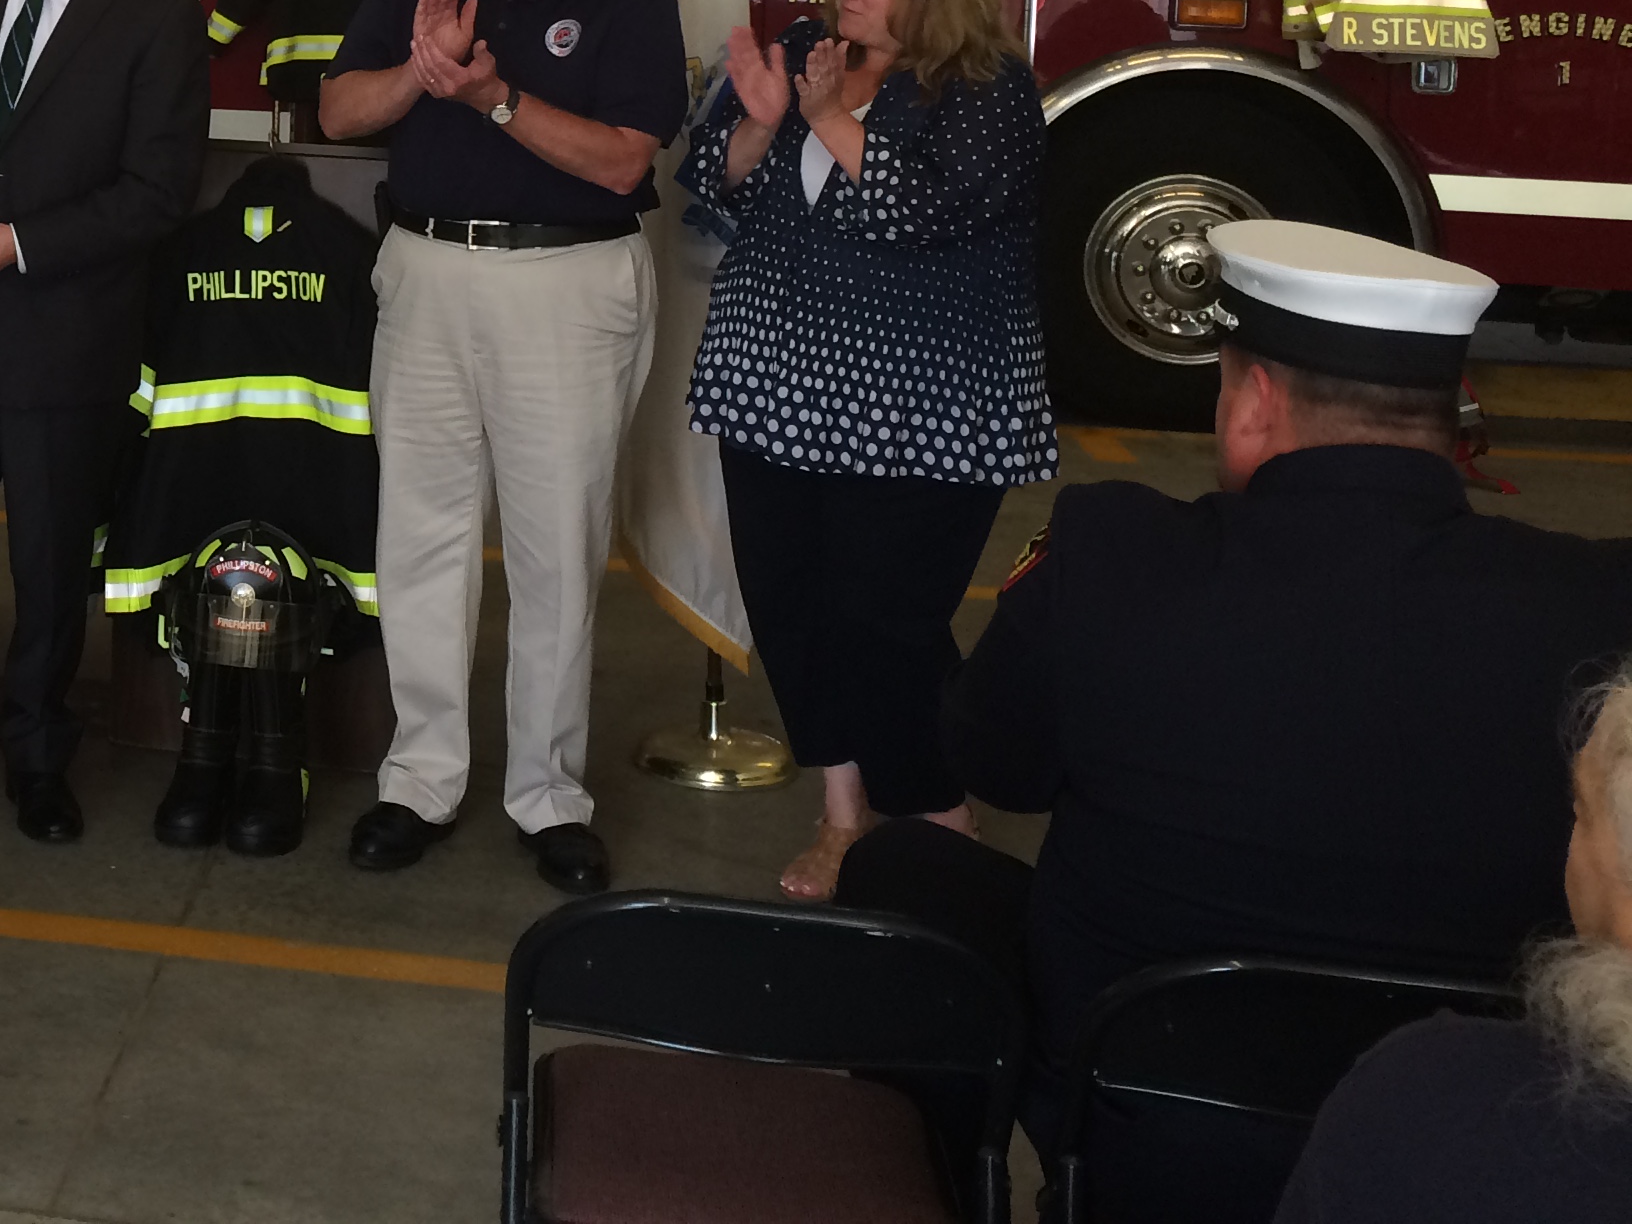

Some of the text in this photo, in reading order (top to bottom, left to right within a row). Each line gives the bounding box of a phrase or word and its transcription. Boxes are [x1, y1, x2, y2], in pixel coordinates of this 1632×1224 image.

[1342, 17, 1487, 50] R. STEVENS
[1494, 12, 1632, 48] ENGINE
[1557, 61, 1571, 87] 1
[187, 269, 325, 303] PHILLIPSTON
